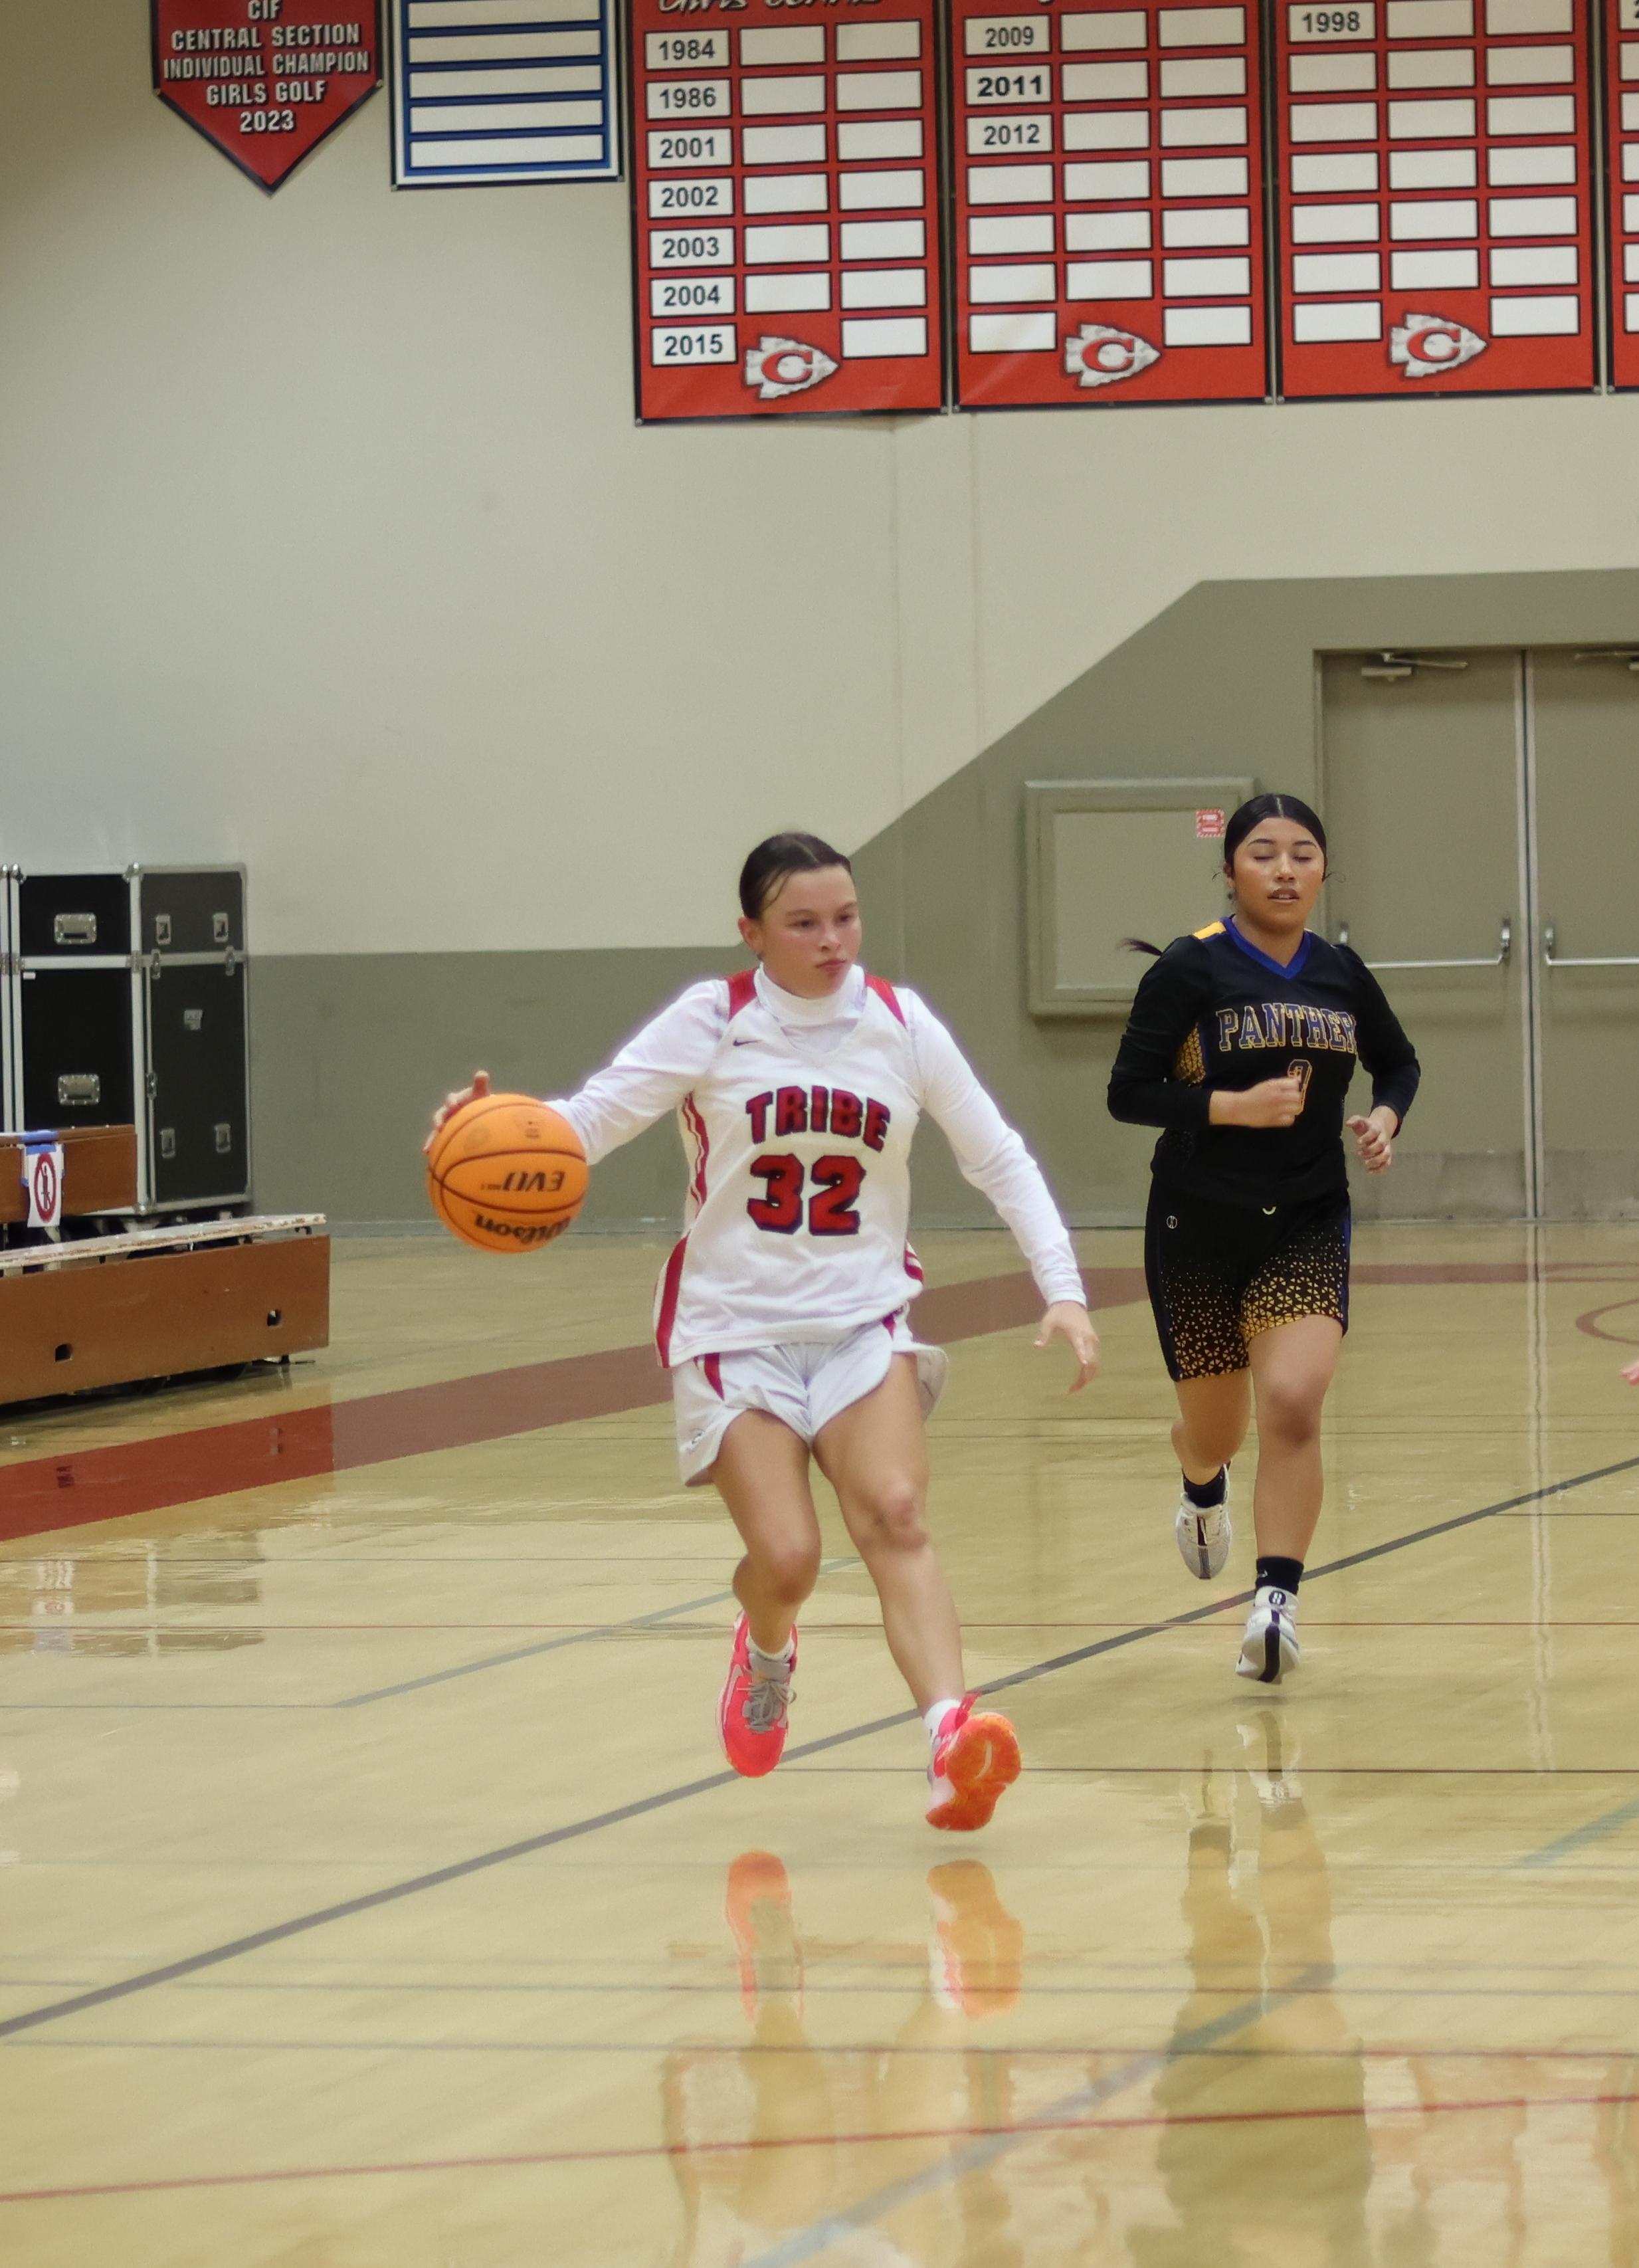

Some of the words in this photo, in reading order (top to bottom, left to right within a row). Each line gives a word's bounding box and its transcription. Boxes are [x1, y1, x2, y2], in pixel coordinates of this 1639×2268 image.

[248, 0, 282, 21] CIF
[1302, 11, 1361, 33] 1998
[171, 27, 262, 51] CENTRAL
[271, 23, 361, 47] SECTION
[985, 26, 1034, 48] 2009
[658, 39, 716, 60] 1984
[163, 55, 266, 80] INDIVIDUAL
[272, 52, 369, 75] CHAMPION
[206, 83, 267, 106] GIRLS
[275, 80, 327, 102] GOLF
[659, 86, 717, 109] 1986
[977, 76, 1043, 98] 2011
[239, 110, 295, 132] 2023
[983, 124, 1040, 146] 2012
[660, 136, 716, 159] 2001
[661, 185, 719, 208] 2002
[662, 236, 720, 258] 2003
[664, 285, 721, 308] 2004
[664, 334, 723, 356] 2015
[745, 1084, 891, 1153] TRIBE
[747, 1153, 866, 1236] 32
